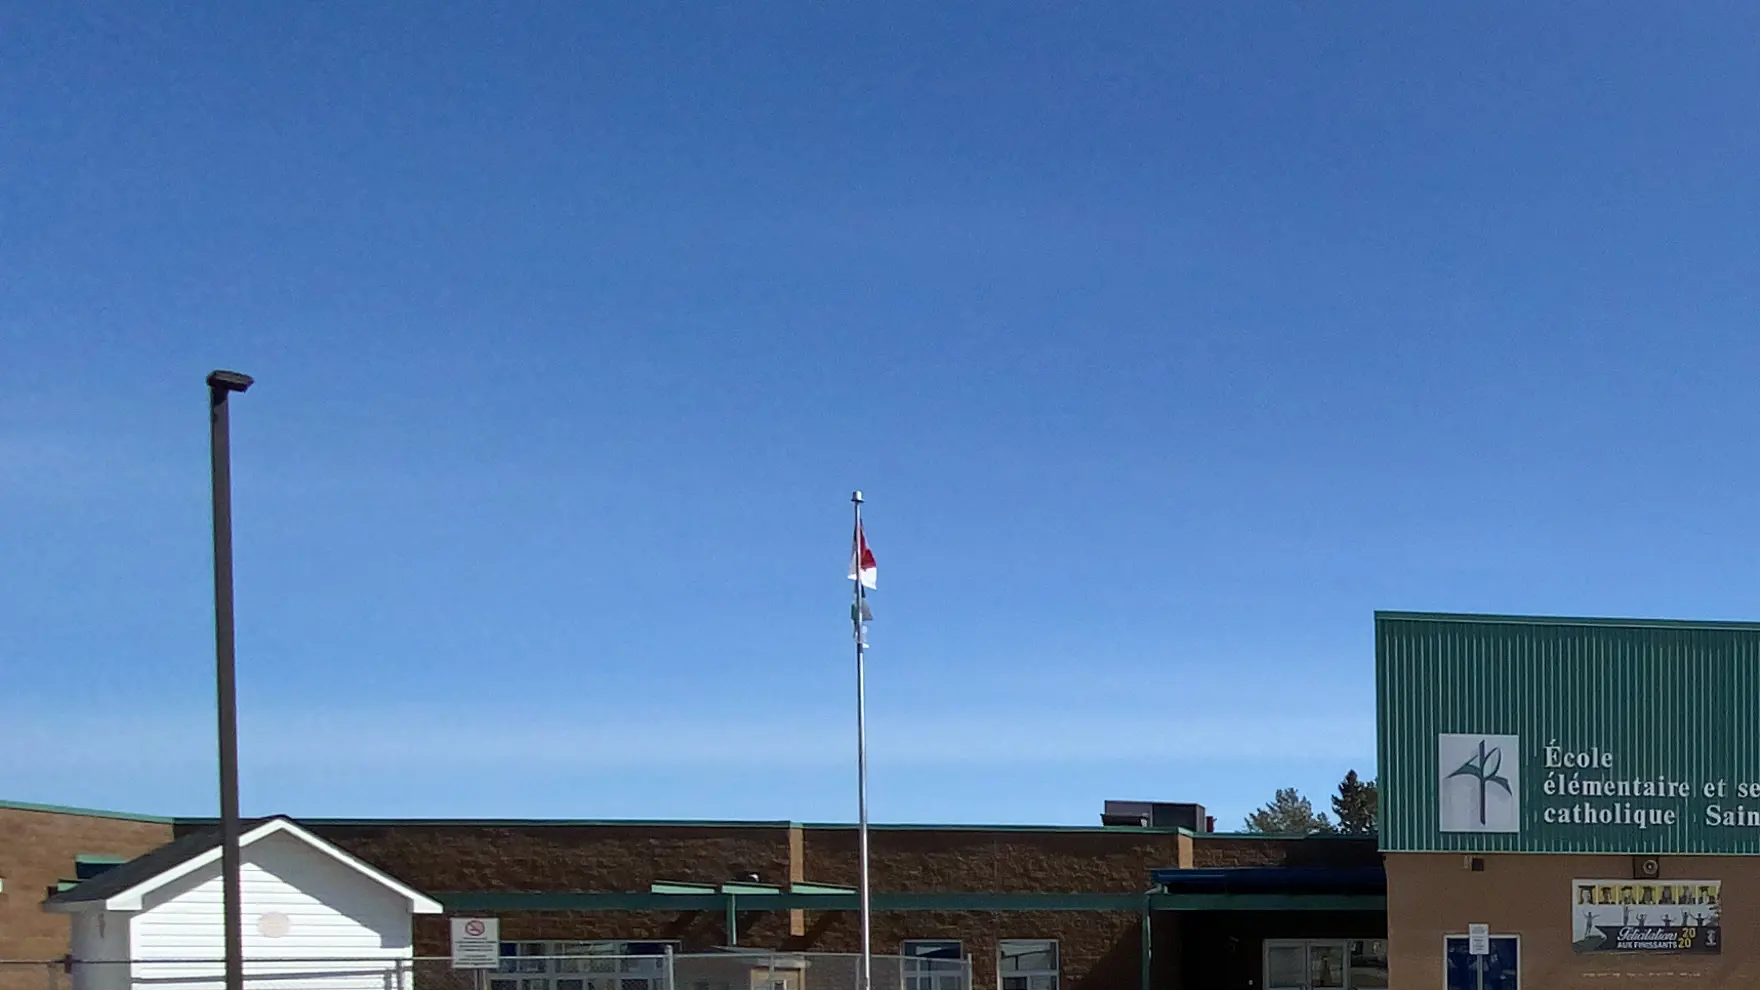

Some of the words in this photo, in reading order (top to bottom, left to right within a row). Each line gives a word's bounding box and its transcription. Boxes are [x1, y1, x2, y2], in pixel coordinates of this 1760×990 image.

[1544, 738, 1613, 768] École
[1543, 772, 1690, 797] élémentaire
[1703, 778, 1727, 798] et
[1544, 802, 1676, 829] catholique
[1678, 938, 1691, 948] 20
[1682, 927, 1696, 938] 20
